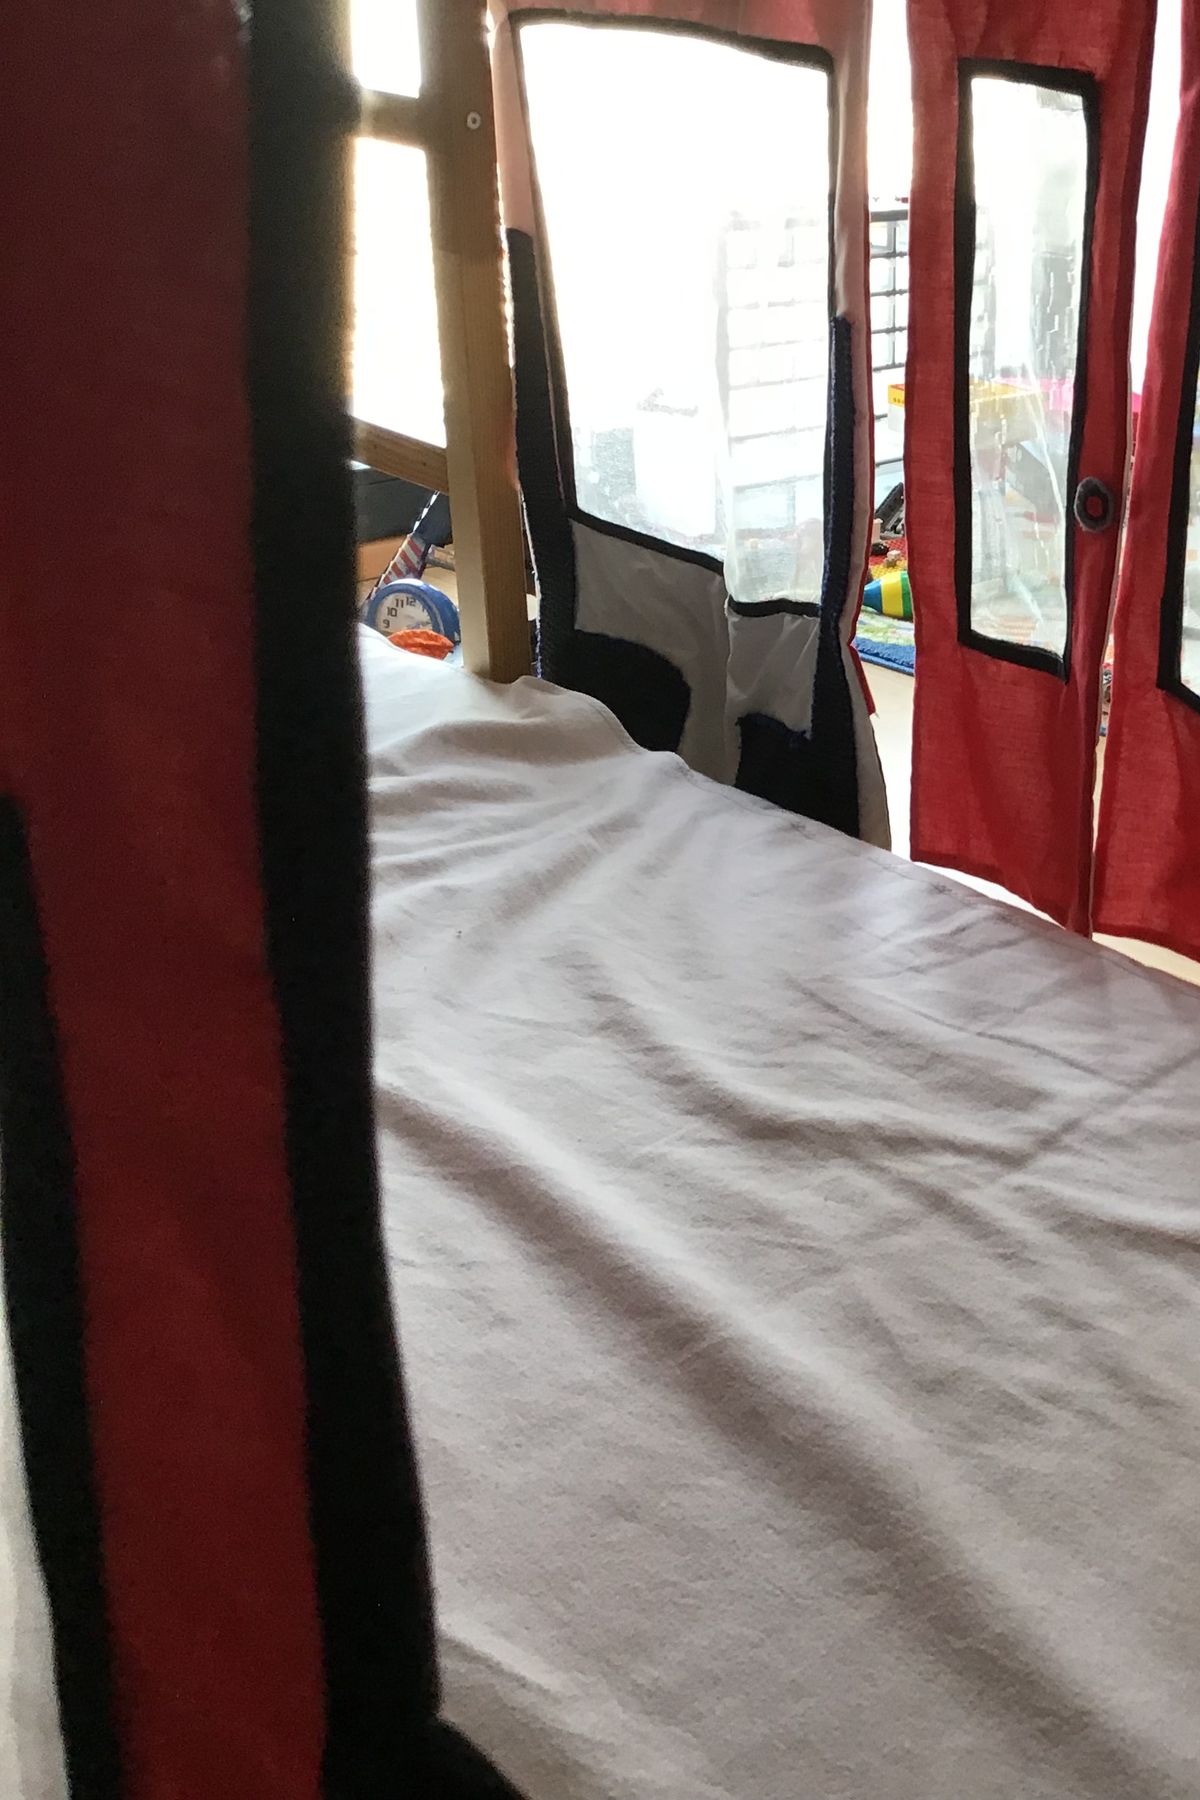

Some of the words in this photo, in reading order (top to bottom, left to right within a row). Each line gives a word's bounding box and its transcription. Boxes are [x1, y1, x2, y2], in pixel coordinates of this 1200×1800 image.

[395, 598, 405, 609] 11
[387, 606, 399, 618] 10
[382, 618, 391, 630] 9
